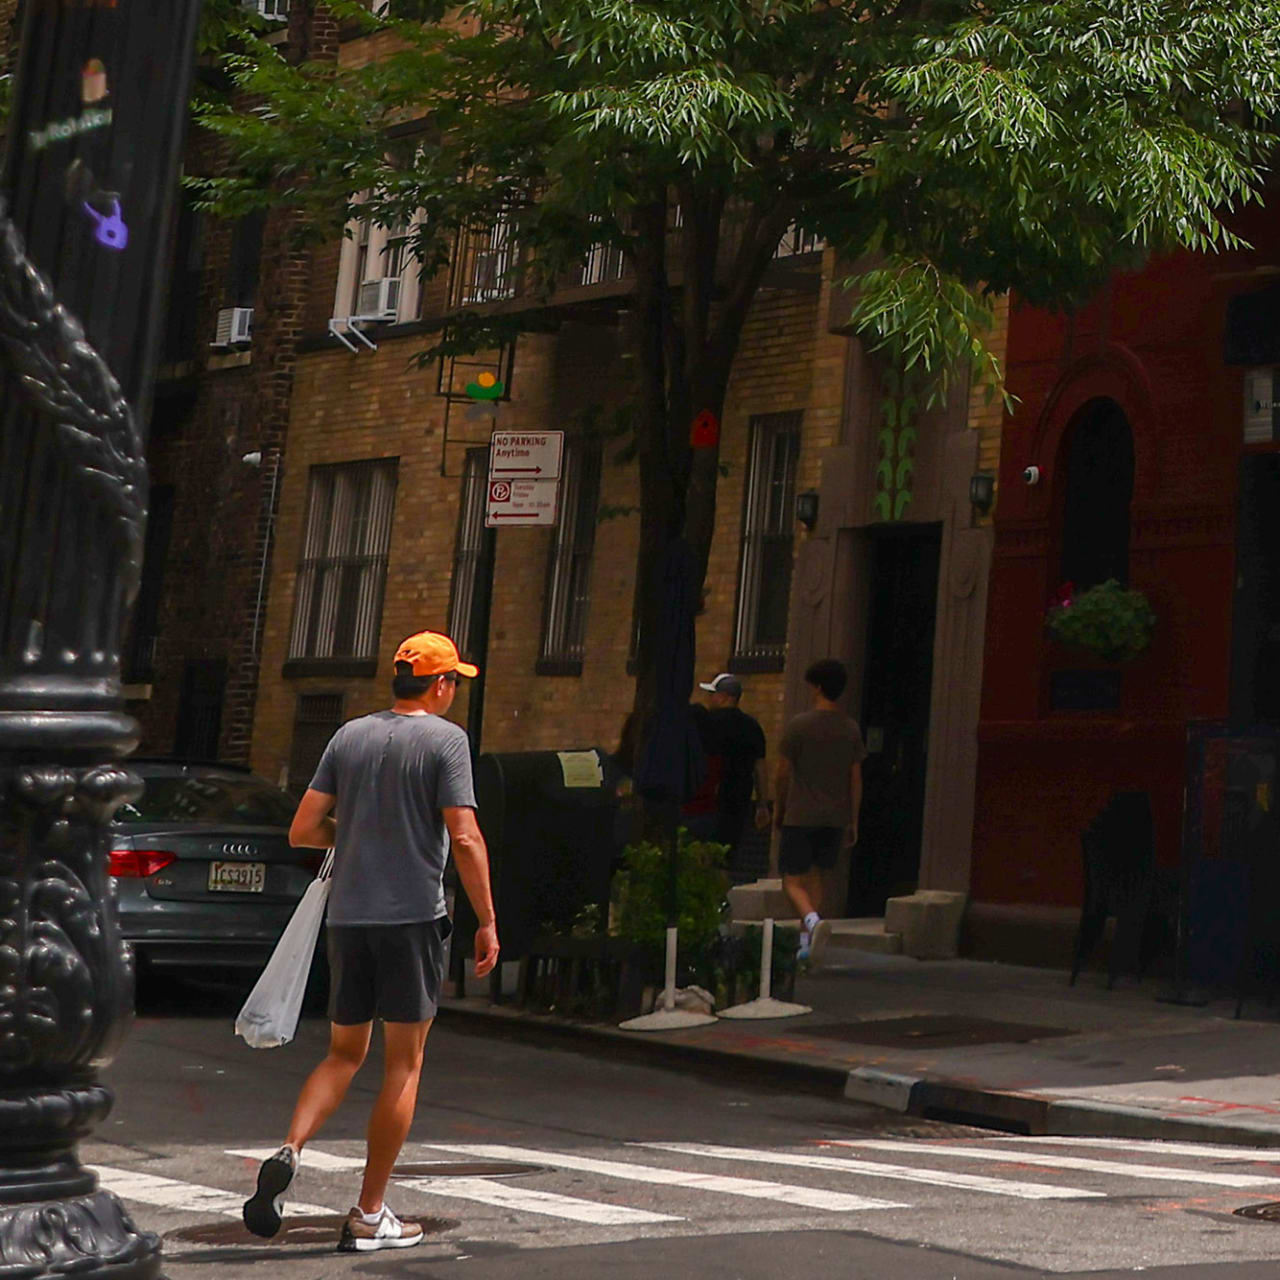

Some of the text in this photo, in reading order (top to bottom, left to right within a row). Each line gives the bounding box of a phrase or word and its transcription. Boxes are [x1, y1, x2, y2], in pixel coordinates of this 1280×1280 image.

[495, 436, 548, 447] NO PARKING
[495, 448, 530, 458] Anytime
